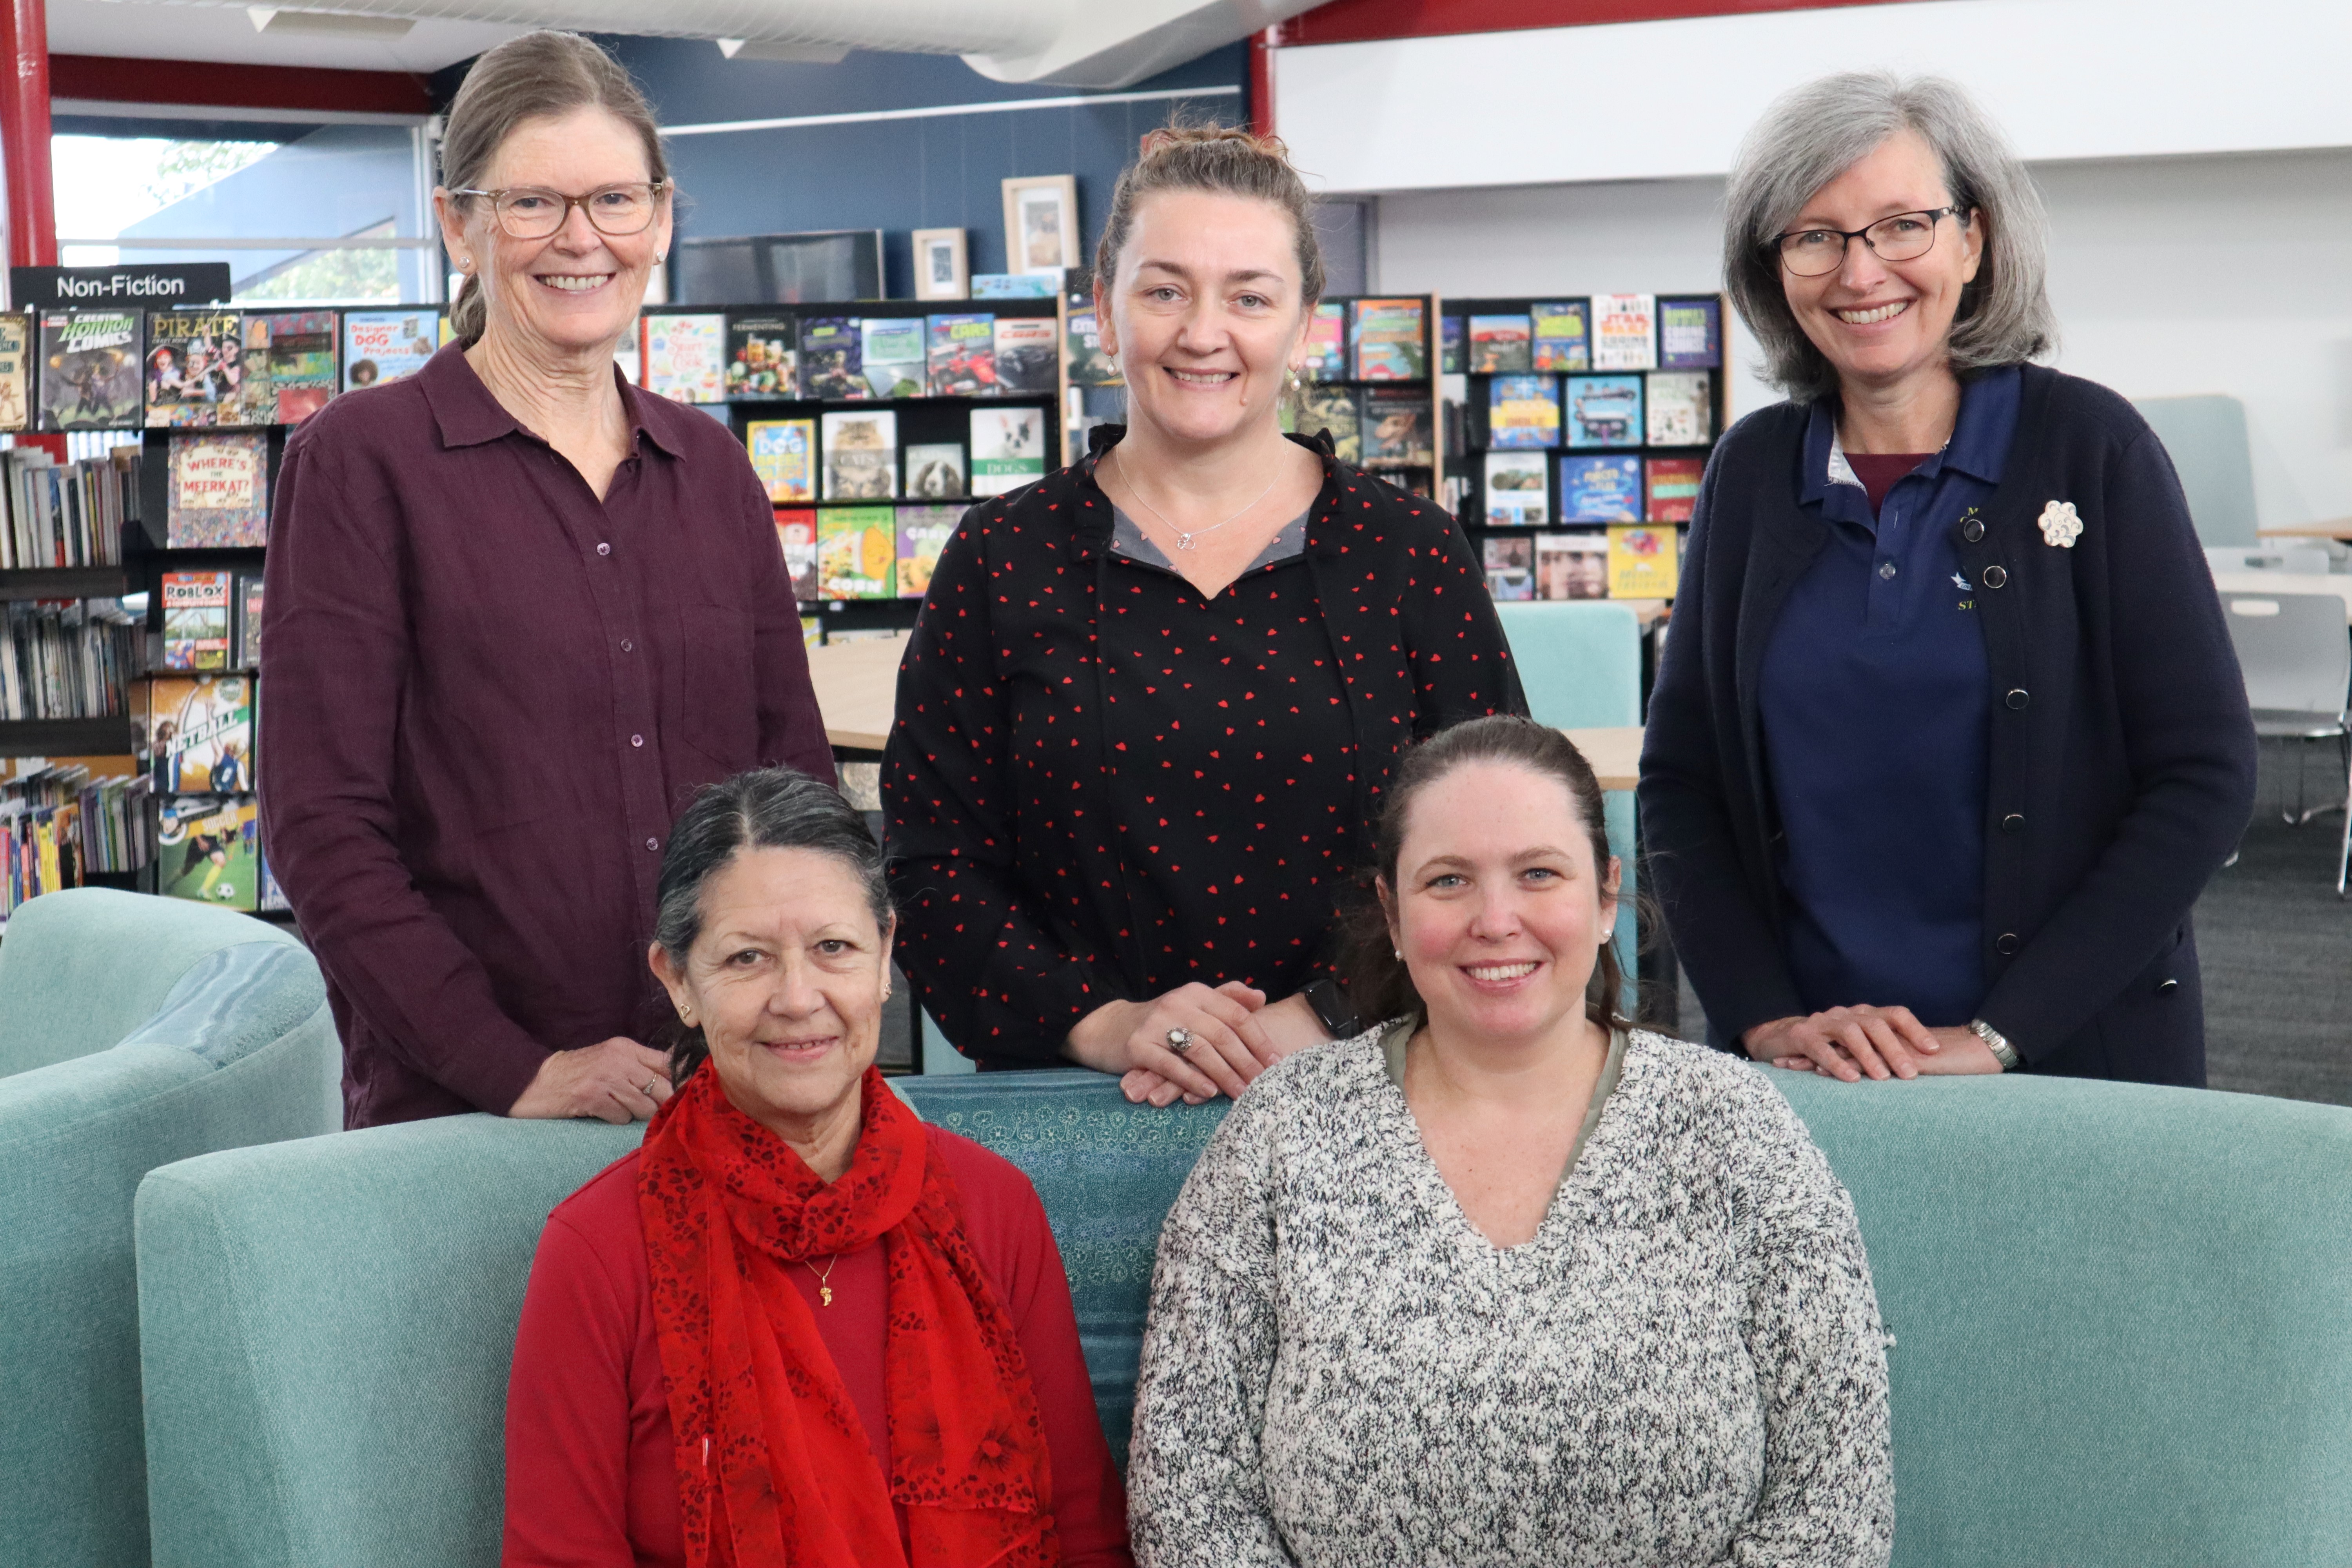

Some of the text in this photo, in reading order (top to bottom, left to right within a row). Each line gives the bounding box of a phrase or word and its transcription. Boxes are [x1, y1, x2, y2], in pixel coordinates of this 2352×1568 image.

[57, 274, 185, 297] Non-Fiction
[153, 315, 238, 338] PIRATE
[1601, 314, 1649, 326] STAR
[351, 324, 398, 333] Designer
[950, 323, 991, 339] CARS
[66, 330, 132, 353] COMICS
[355, 334, 389, 346] DOG
[364, 346, 409, 356] Projects
[759, 438, 802, 454] DOG
[187, 457, 247, 472] WHERE'S
[840, 454, 877, 465] CATS
[757, 468, 805, 481] GUIDE
[183, 480, 249, 493] MEERKAT?
[165, 584, 225, 599] ROBLOX
[828, 576, 882, 594] CORN
[1958, 600, 1976, 610] ST
[165, 710, 238, 758] NETBALL
[201, 811, 237, 832] SOCCER
